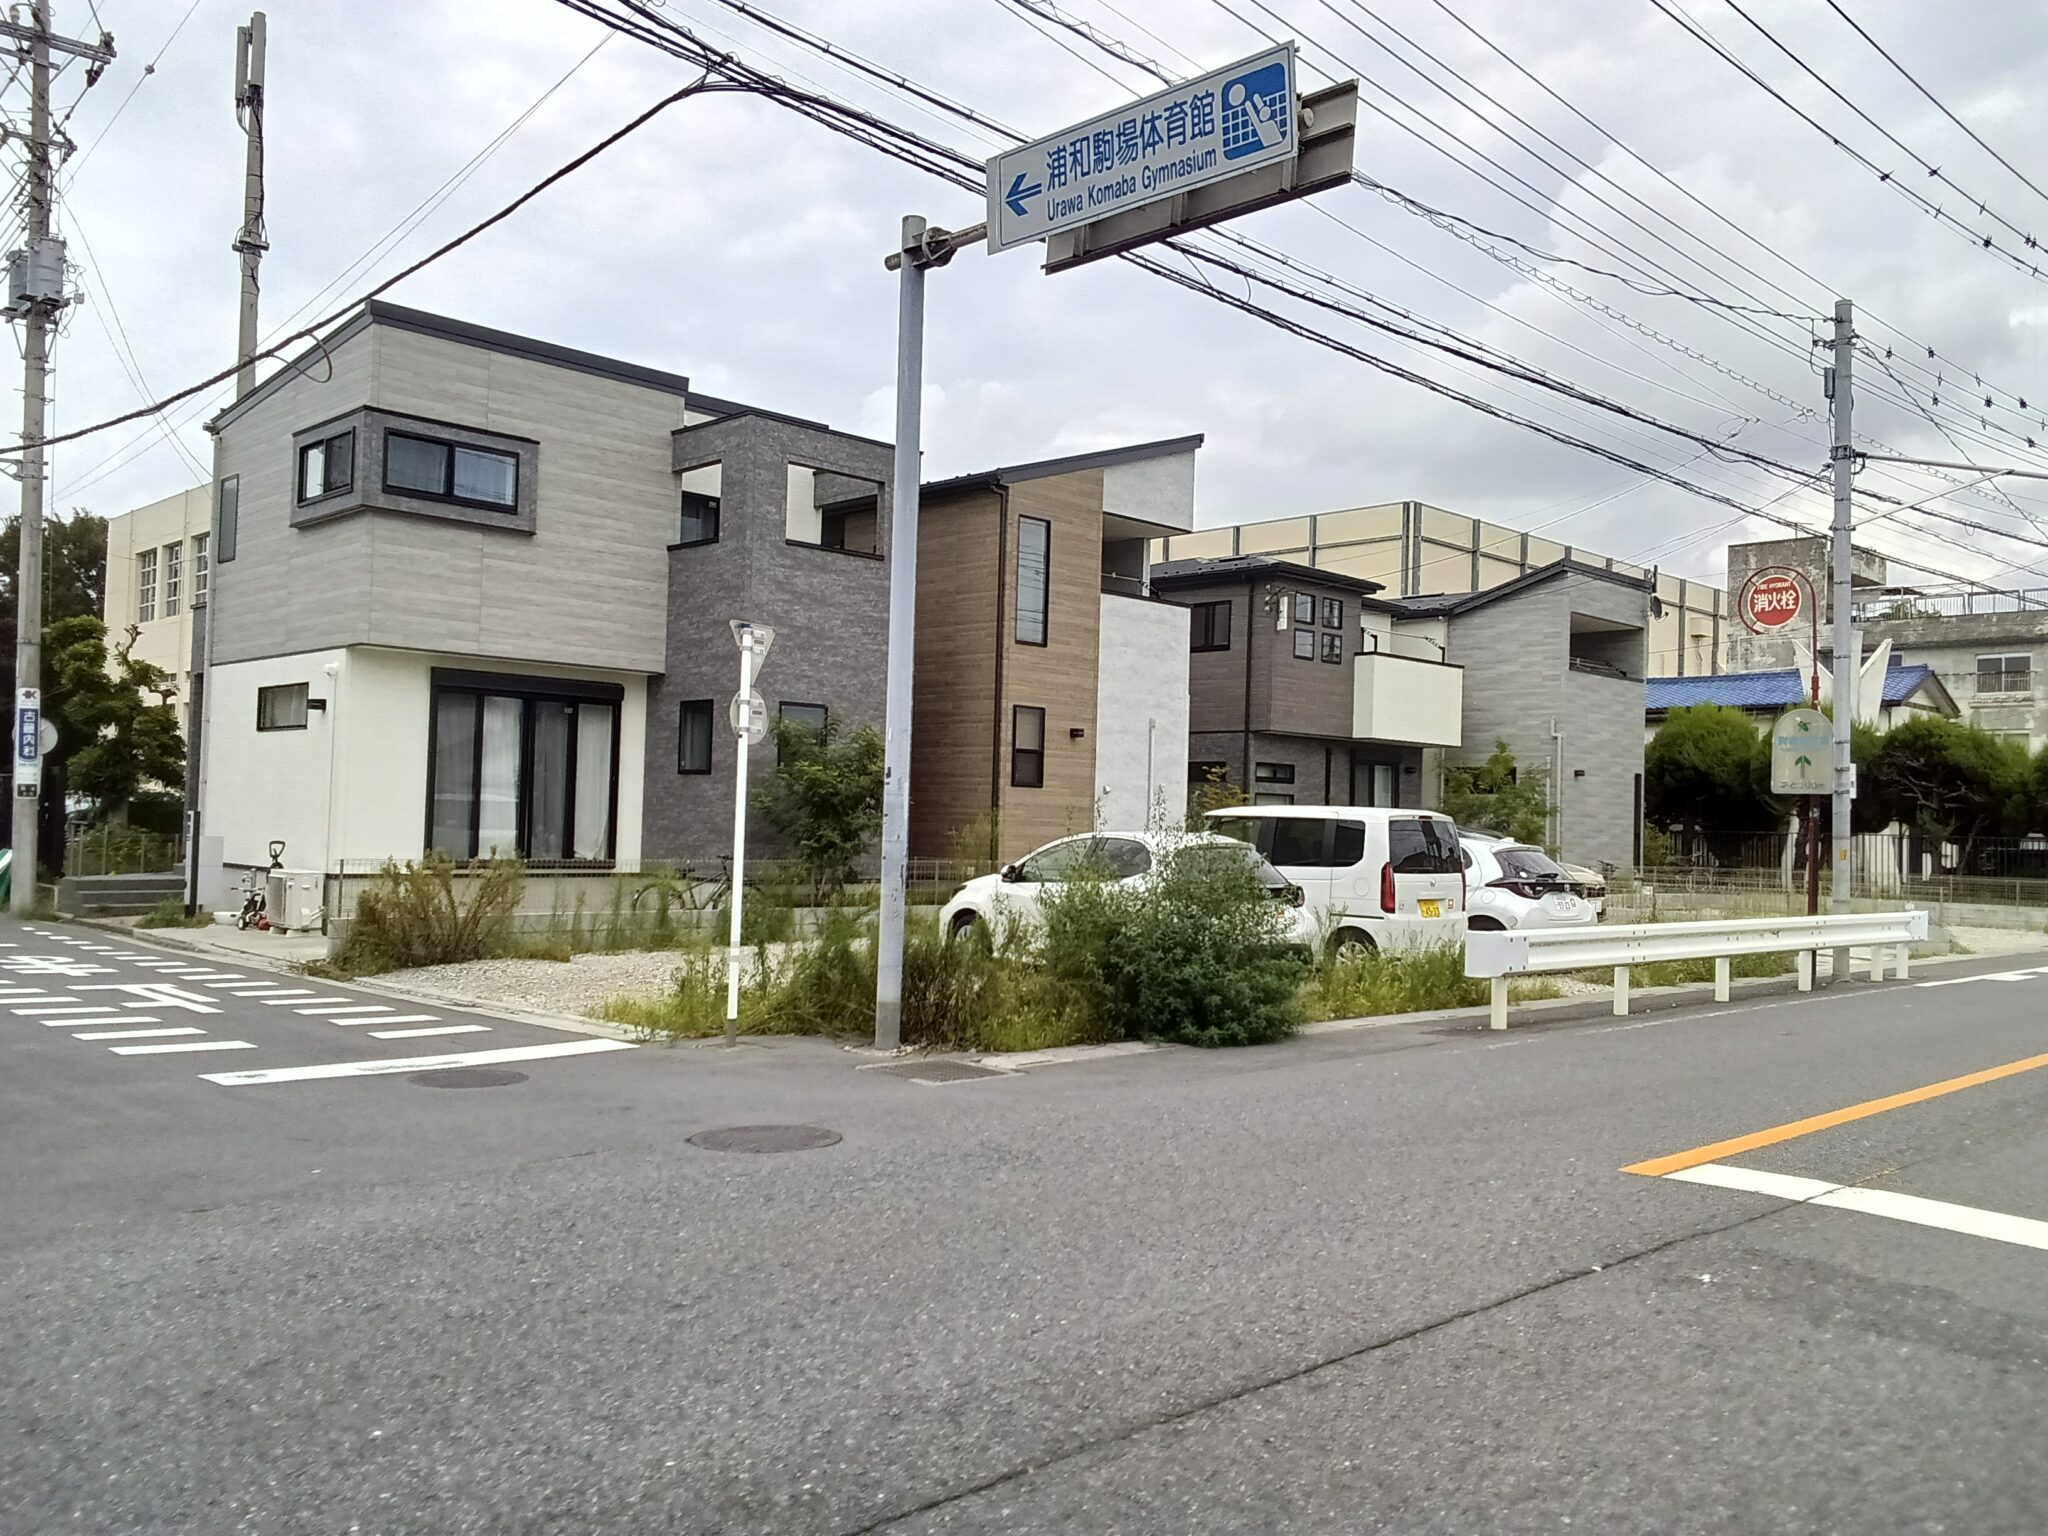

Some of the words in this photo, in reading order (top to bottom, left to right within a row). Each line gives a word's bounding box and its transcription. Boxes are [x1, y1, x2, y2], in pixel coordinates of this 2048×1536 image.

[1047, 89, 1215, 192] 浦和駒場体育館
[1047, 194, 1083, 222] Urawa
[1087, 175, 1137, 207] Komaba
[1142, 148, 1216, 190] Gymnasium
[1753, 590, 1797, 613] 消火栓
